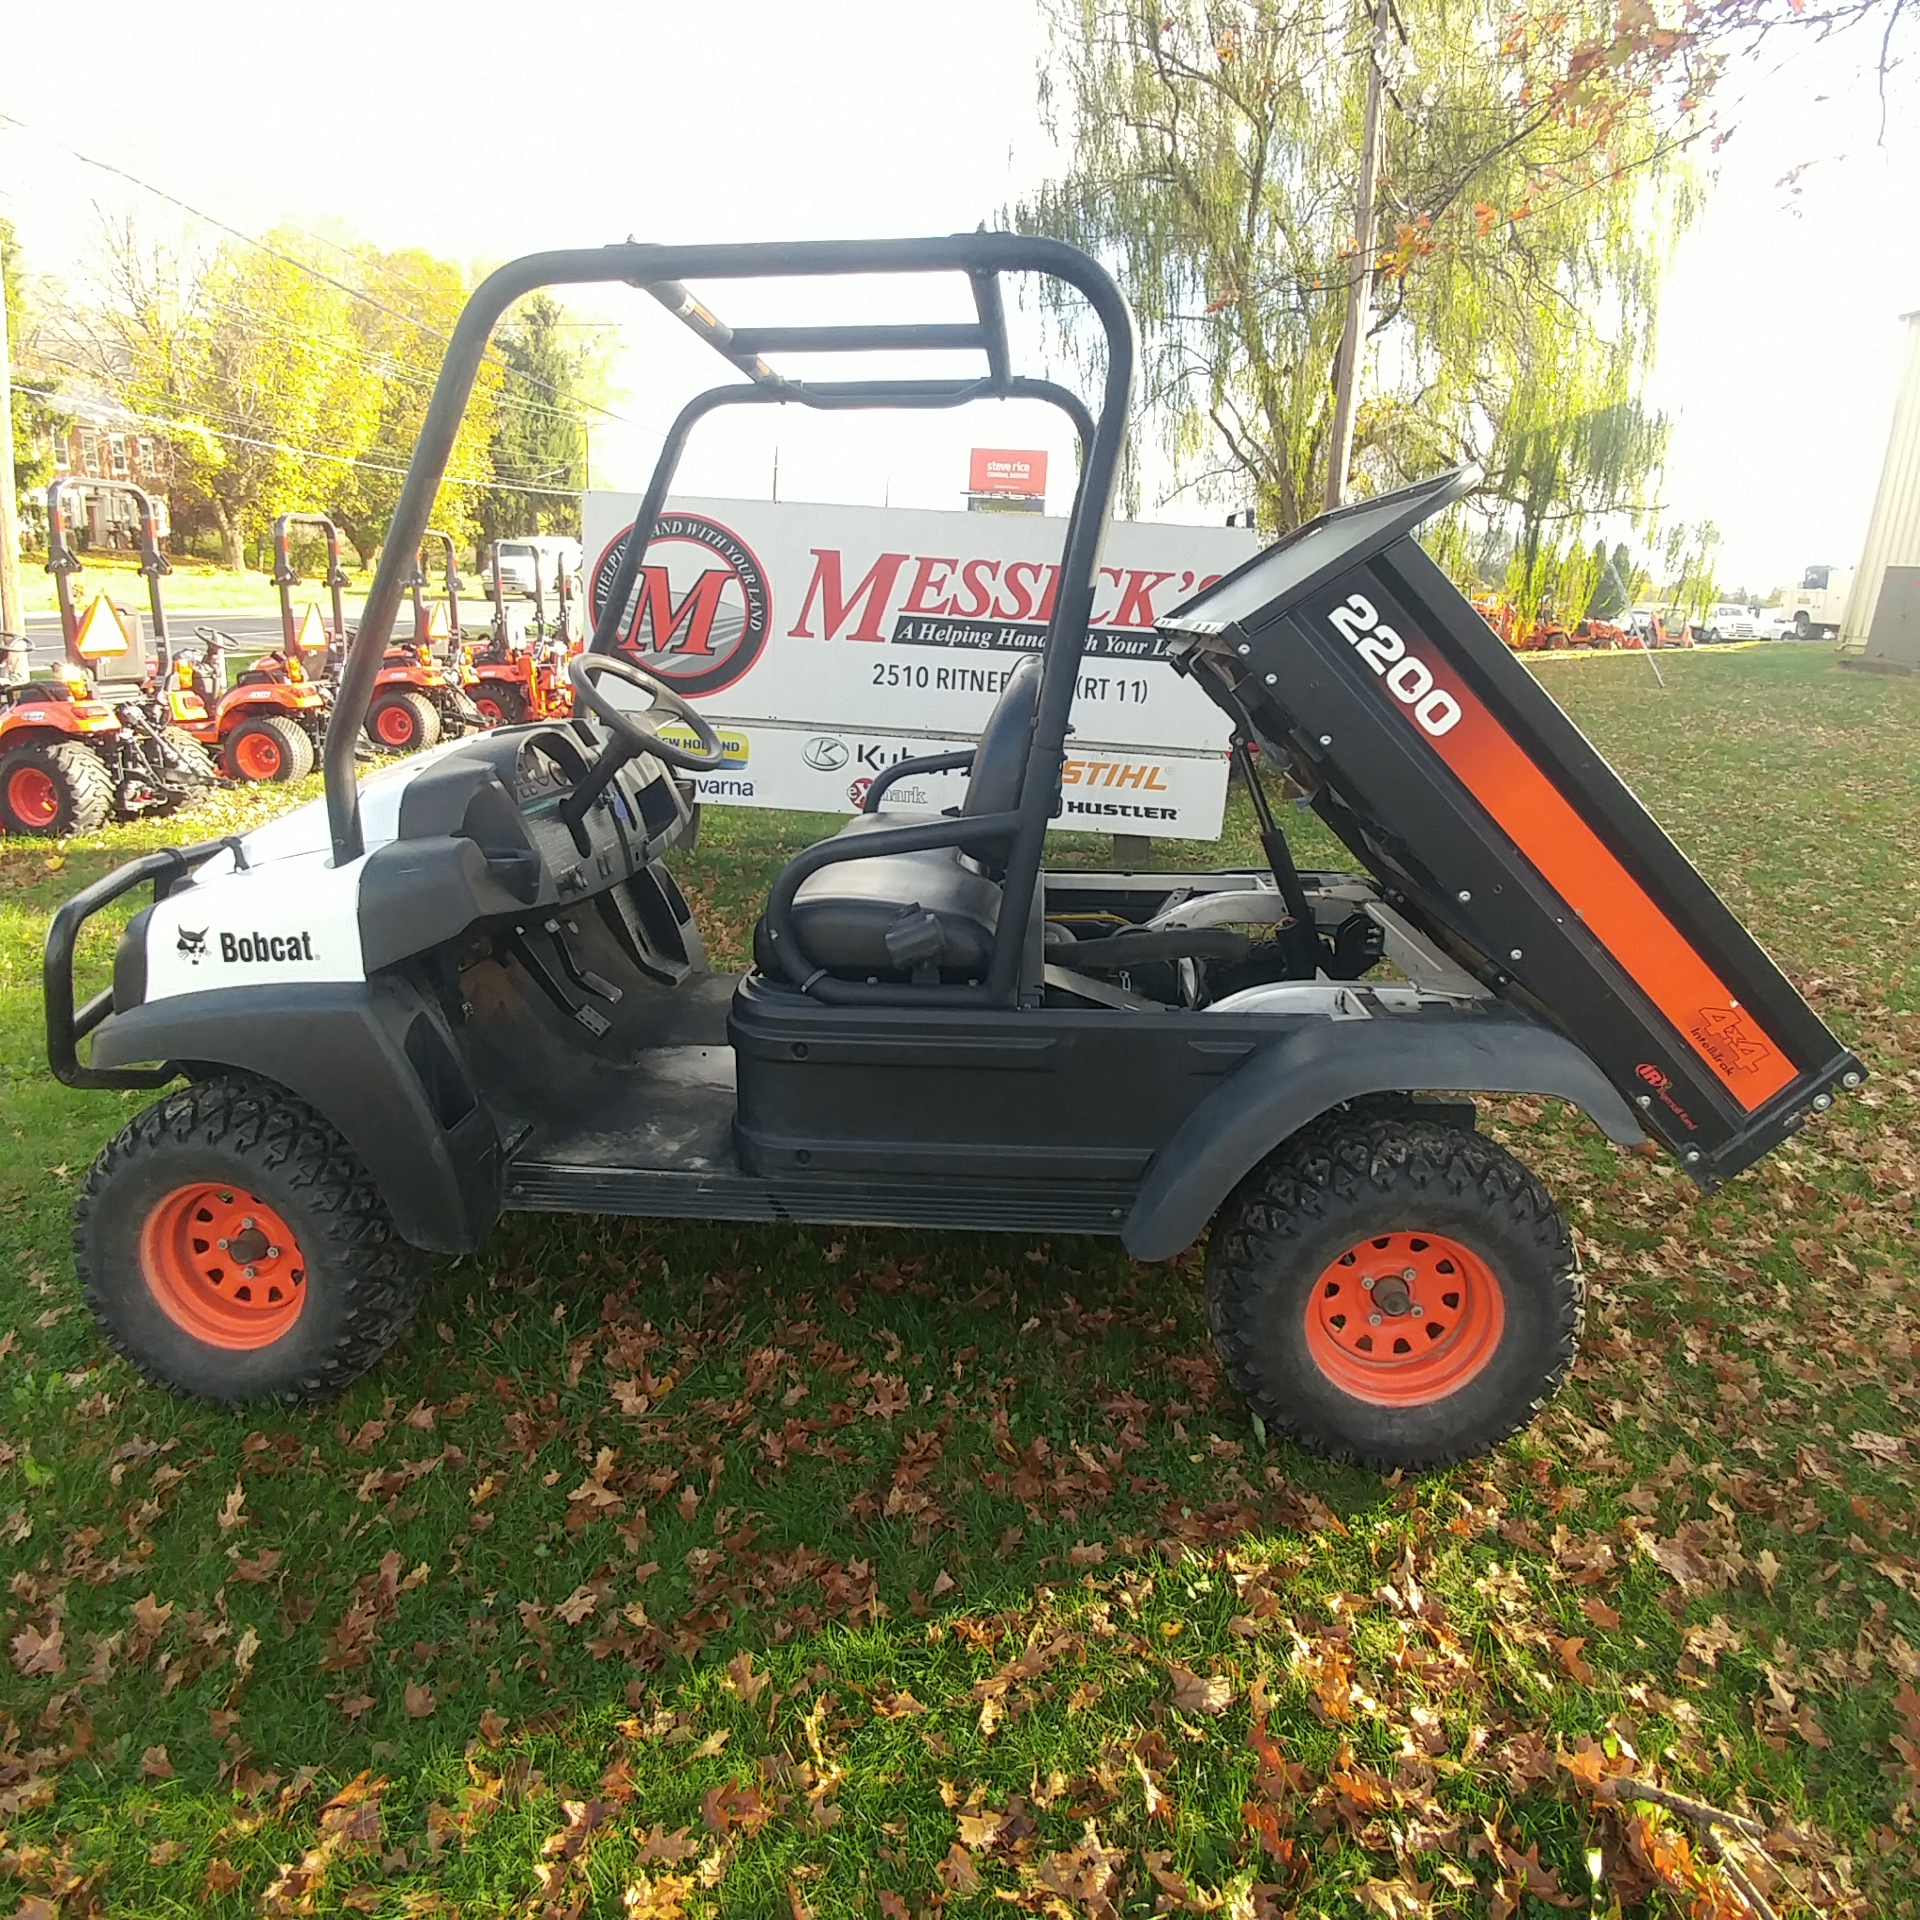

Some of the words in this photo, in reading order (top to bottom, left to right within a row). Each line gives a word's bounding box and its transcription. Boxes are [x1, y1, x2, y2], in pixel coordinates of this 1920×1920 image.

[596, 540, 628, 596] HELPIN
[651, 521, 683, 538] AND
[686, 522, 727, 549] WITH
[725, 544, 756, 585] YOUR
[748, 587, 763, 631] LAND
[787, 549, 1222, 643] MESSIK'
[898, 622, 914, 640] A
[917, 623, 993, 649] Helping
[1104, 635, 1148, 655] Your
[873, 663, 929, 688] 2510
[1076, 675, 1111, 700] (RT
[1116, 679, 1148, 704] 11)
[1327, 593, 1462, 737] 2200
[1062, 761, 1168, 791] STIHL
[1067, 801, 1178, 820] HUSTLER
[219, 931, 314, 963] Bobcat
